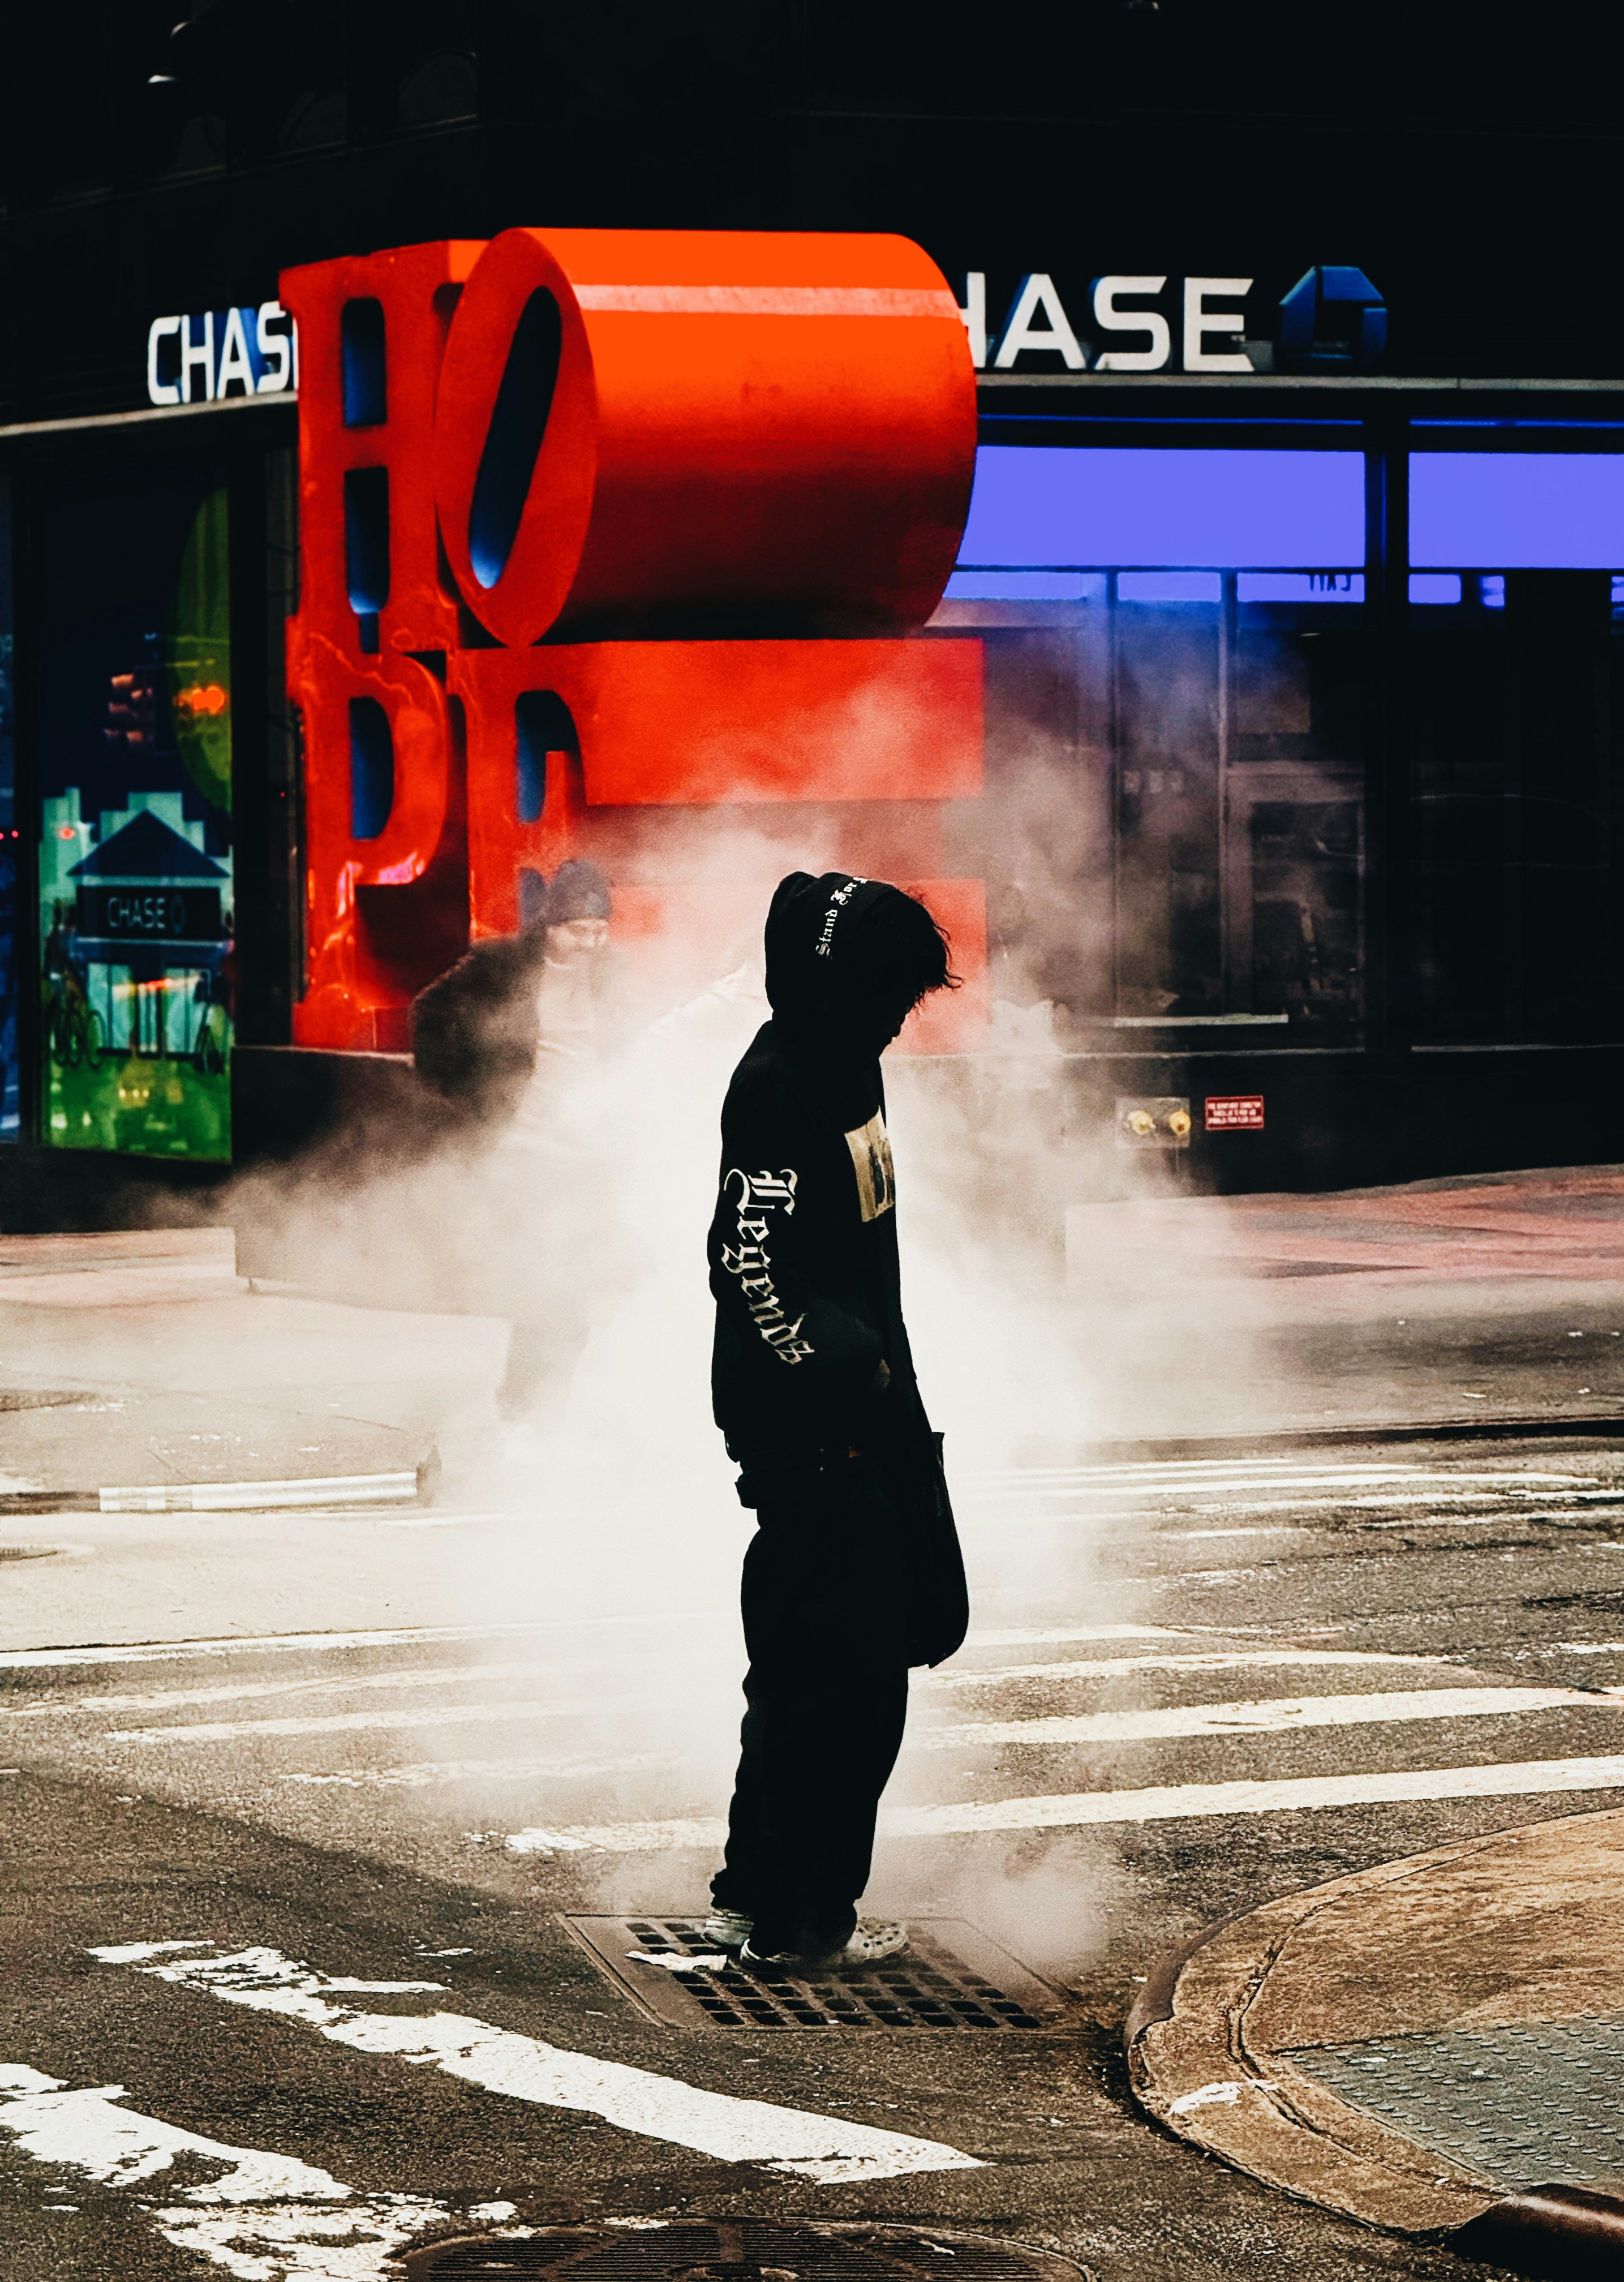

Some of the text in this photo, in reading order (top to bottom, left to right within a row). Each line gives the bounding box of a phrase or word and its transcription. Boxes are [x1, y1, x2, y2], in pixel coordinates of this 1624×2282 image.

[148, 301, 298, 405] CHAS
[108, 897, 165, 928] CHASE
[815, 909, 837, 958] Stand
[721, 1168, 815, 1365] Legends
